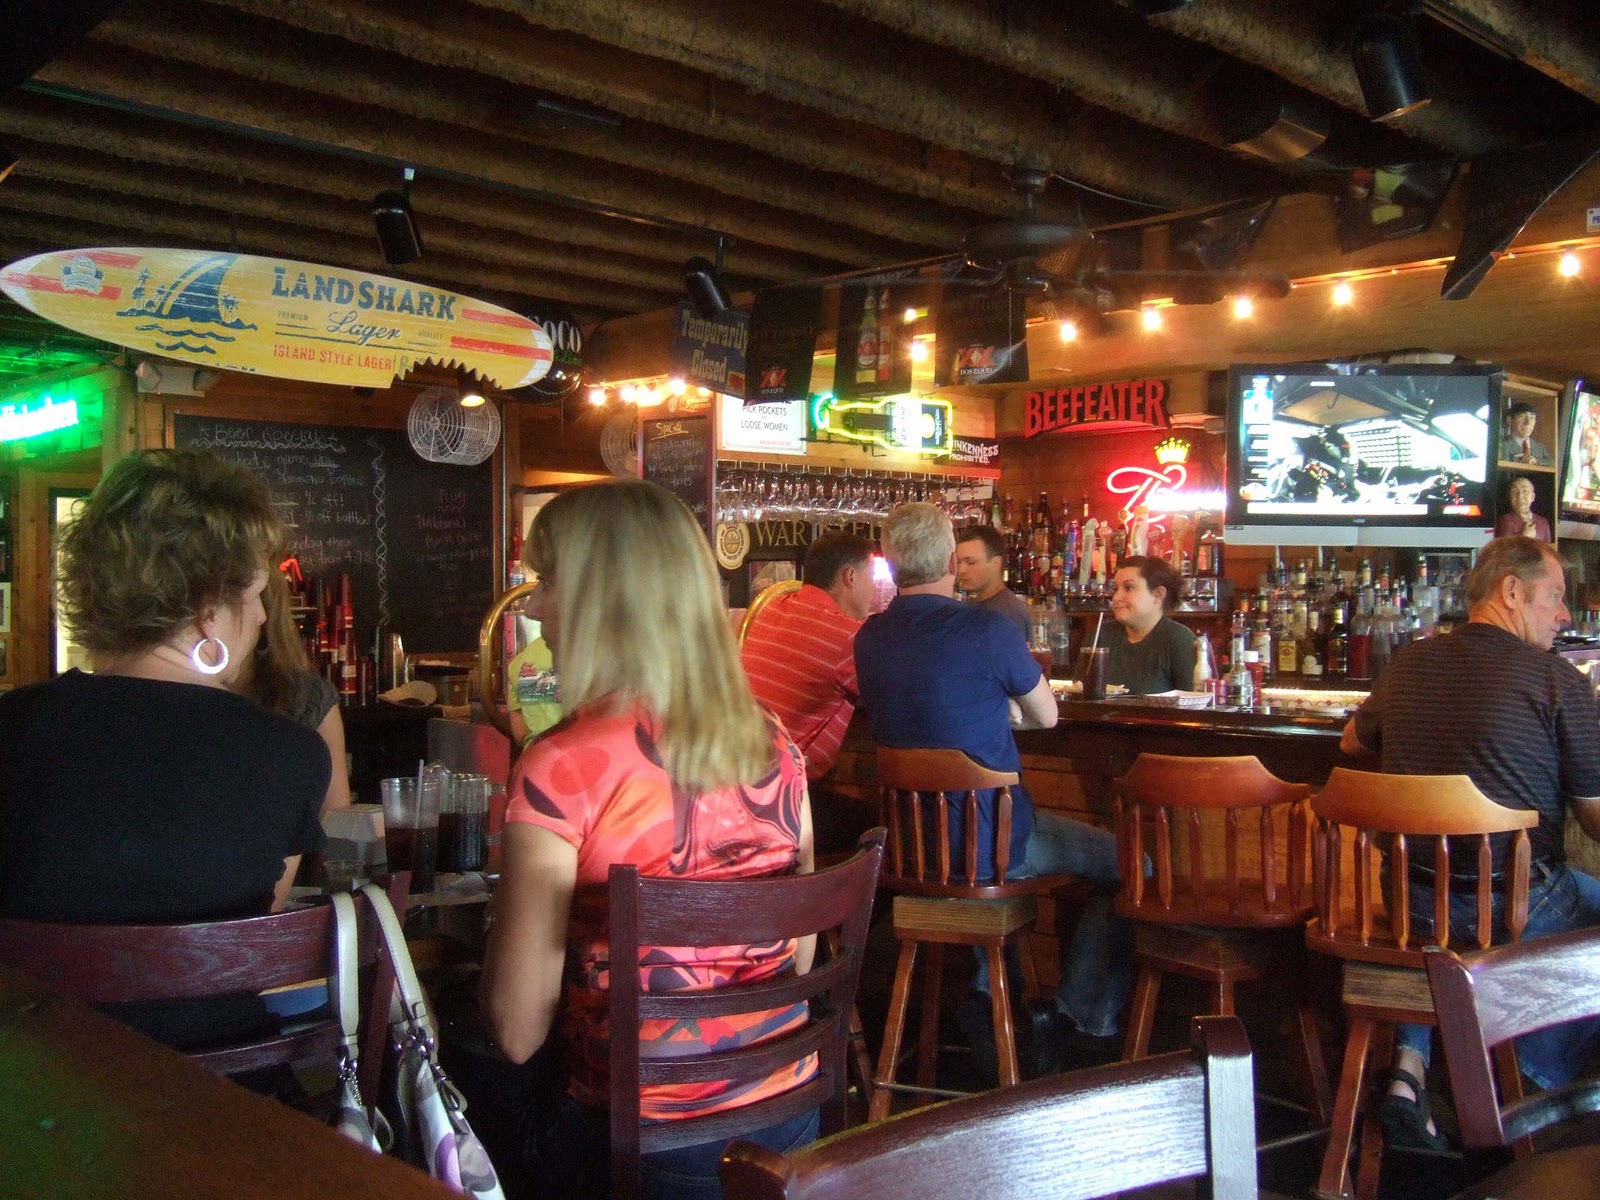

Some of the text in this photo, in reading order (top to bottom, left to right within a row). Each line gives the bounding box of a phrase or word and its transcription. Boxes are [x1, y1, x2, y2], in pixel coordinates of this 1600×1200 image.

[272, 267, 457, 322] LANDSHARK
[326, 310, 402, 346] Lager
[681, 308, 749, 357] Temporarily
[273, 344, 316, 361] ISLAND
[319, 349, 354, 366] STYLE
[357, 353, 393, 371] LAGER
[692, 348, 728, 383] Closed
[740, 418, 788, 432] LOOSE WOMEN
[758, 405, 788, 416] POCKETS
[1025, 379, 1169, 439] BEEFEATER
